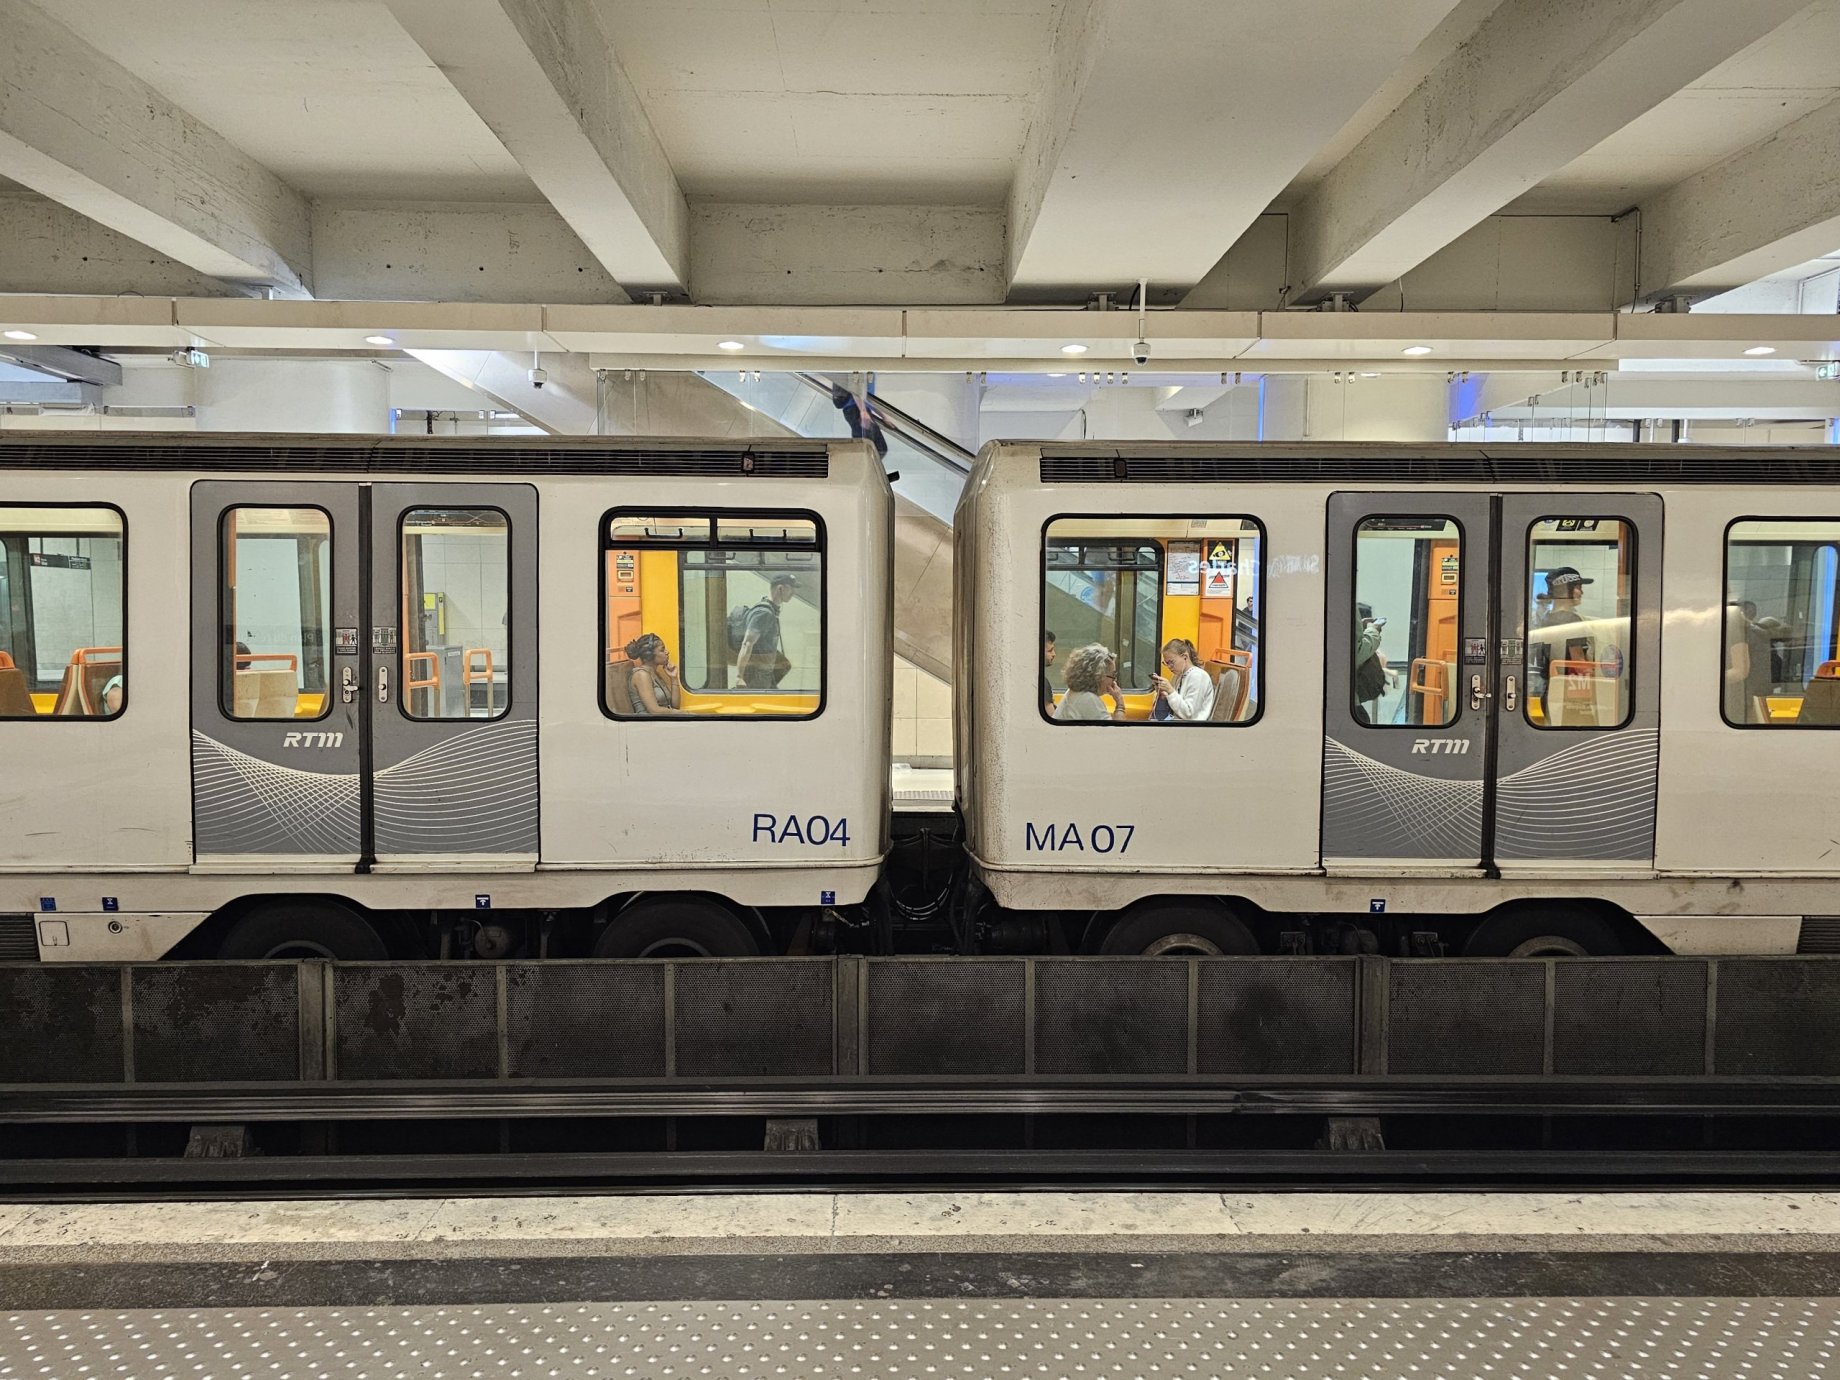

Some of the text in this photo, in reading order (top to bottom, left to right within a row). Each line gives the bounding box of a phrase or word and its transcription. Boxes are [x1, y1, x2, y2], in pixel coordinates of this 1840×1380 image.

[283, 732, 343, 747] RTM
[1411, 739, 1470, 754] RTM
[752, 813, 851, 847] RA04
